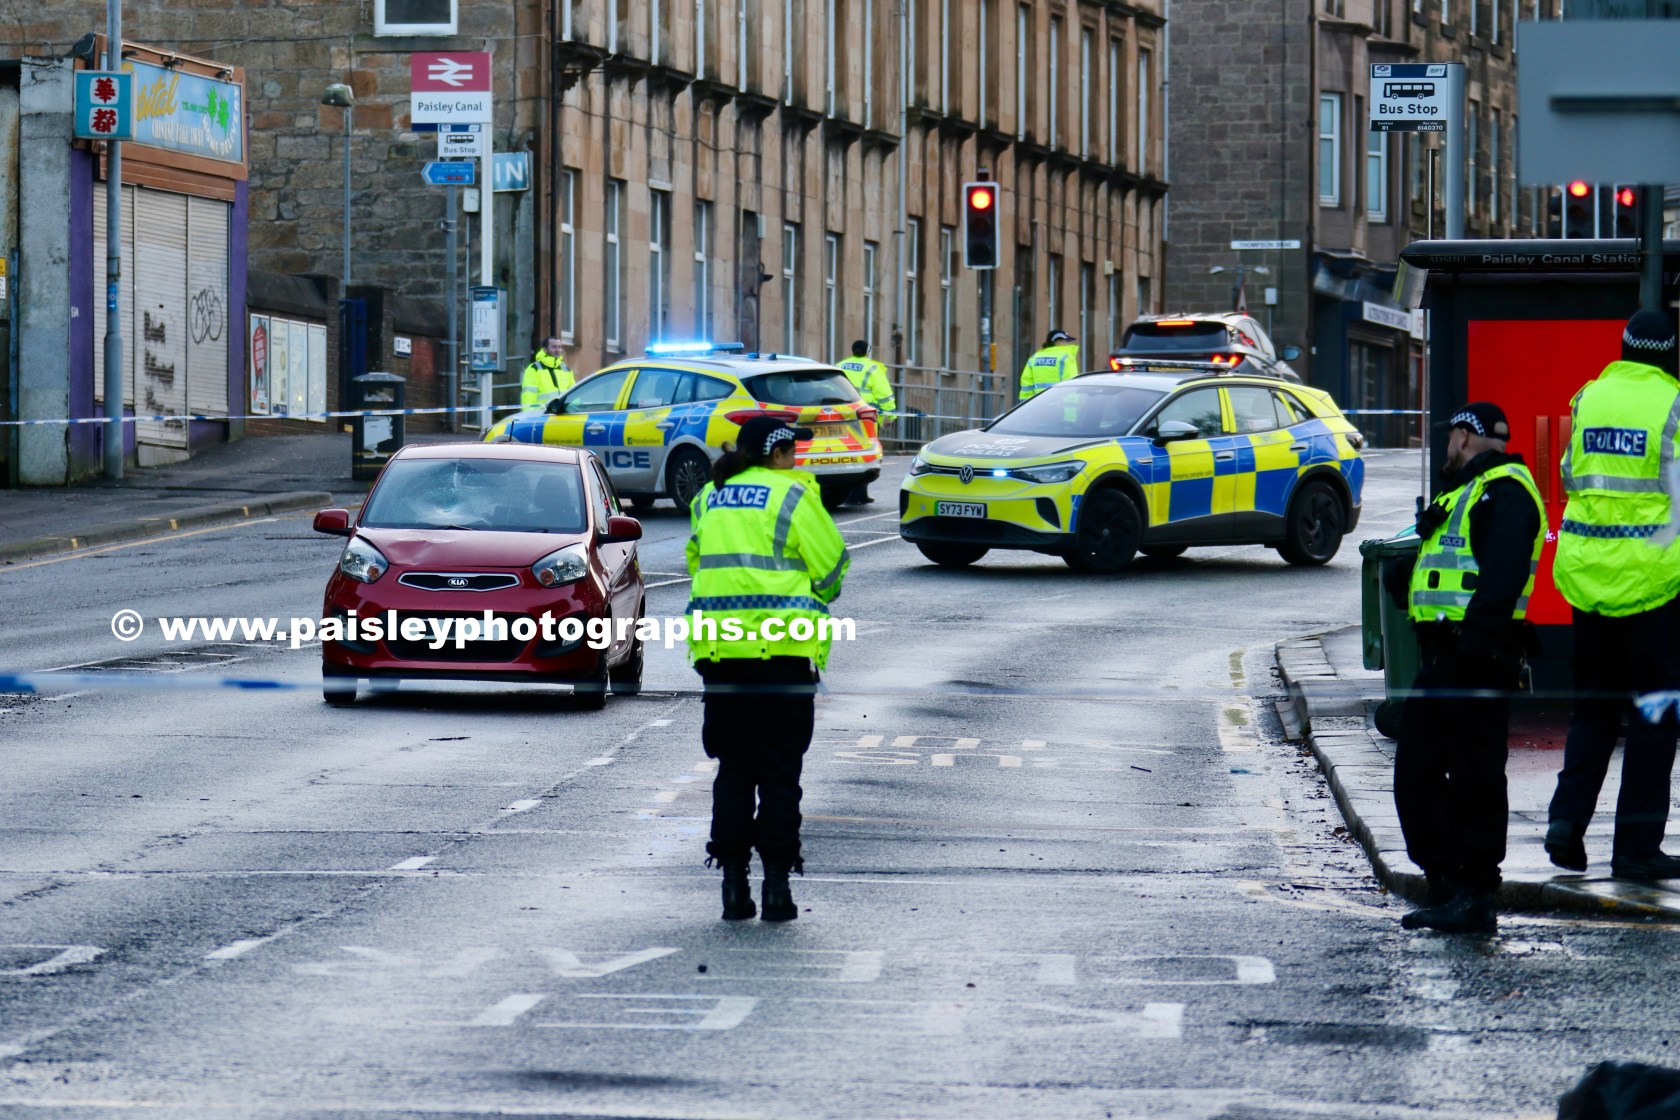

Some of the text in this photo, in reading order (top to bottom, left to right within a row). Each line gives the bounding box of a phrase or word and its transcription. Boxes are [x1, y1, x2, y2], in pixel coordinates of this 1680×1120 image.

[92, 76, 117, 133] 華都
[418, 101, 483, 114] Paisley Canal
[1379, 103, 1439, 116] Bus Stop
[443, 146, 477, 155] Bus Stop
[495, 161, 524, 183] IN
[1482, 254, 1535, 265] Paisley
[1541, 254, 1584, 264] Canal
[842, 363, 864, 371] POLICE
[1034, 358, 1057, 366] POLICE
[962, 444, 1026, 452] POLICE
[1585, 431, 1643, 453] POLICE
[604, 451, 651, 469] ICE
[810, 456, 858, 465] POLICE
[707, 487, 767, 506] POLICE
[939, 503, 983, 517] SY73 FYW
[1441, 536, 1465, 547] POLICE
